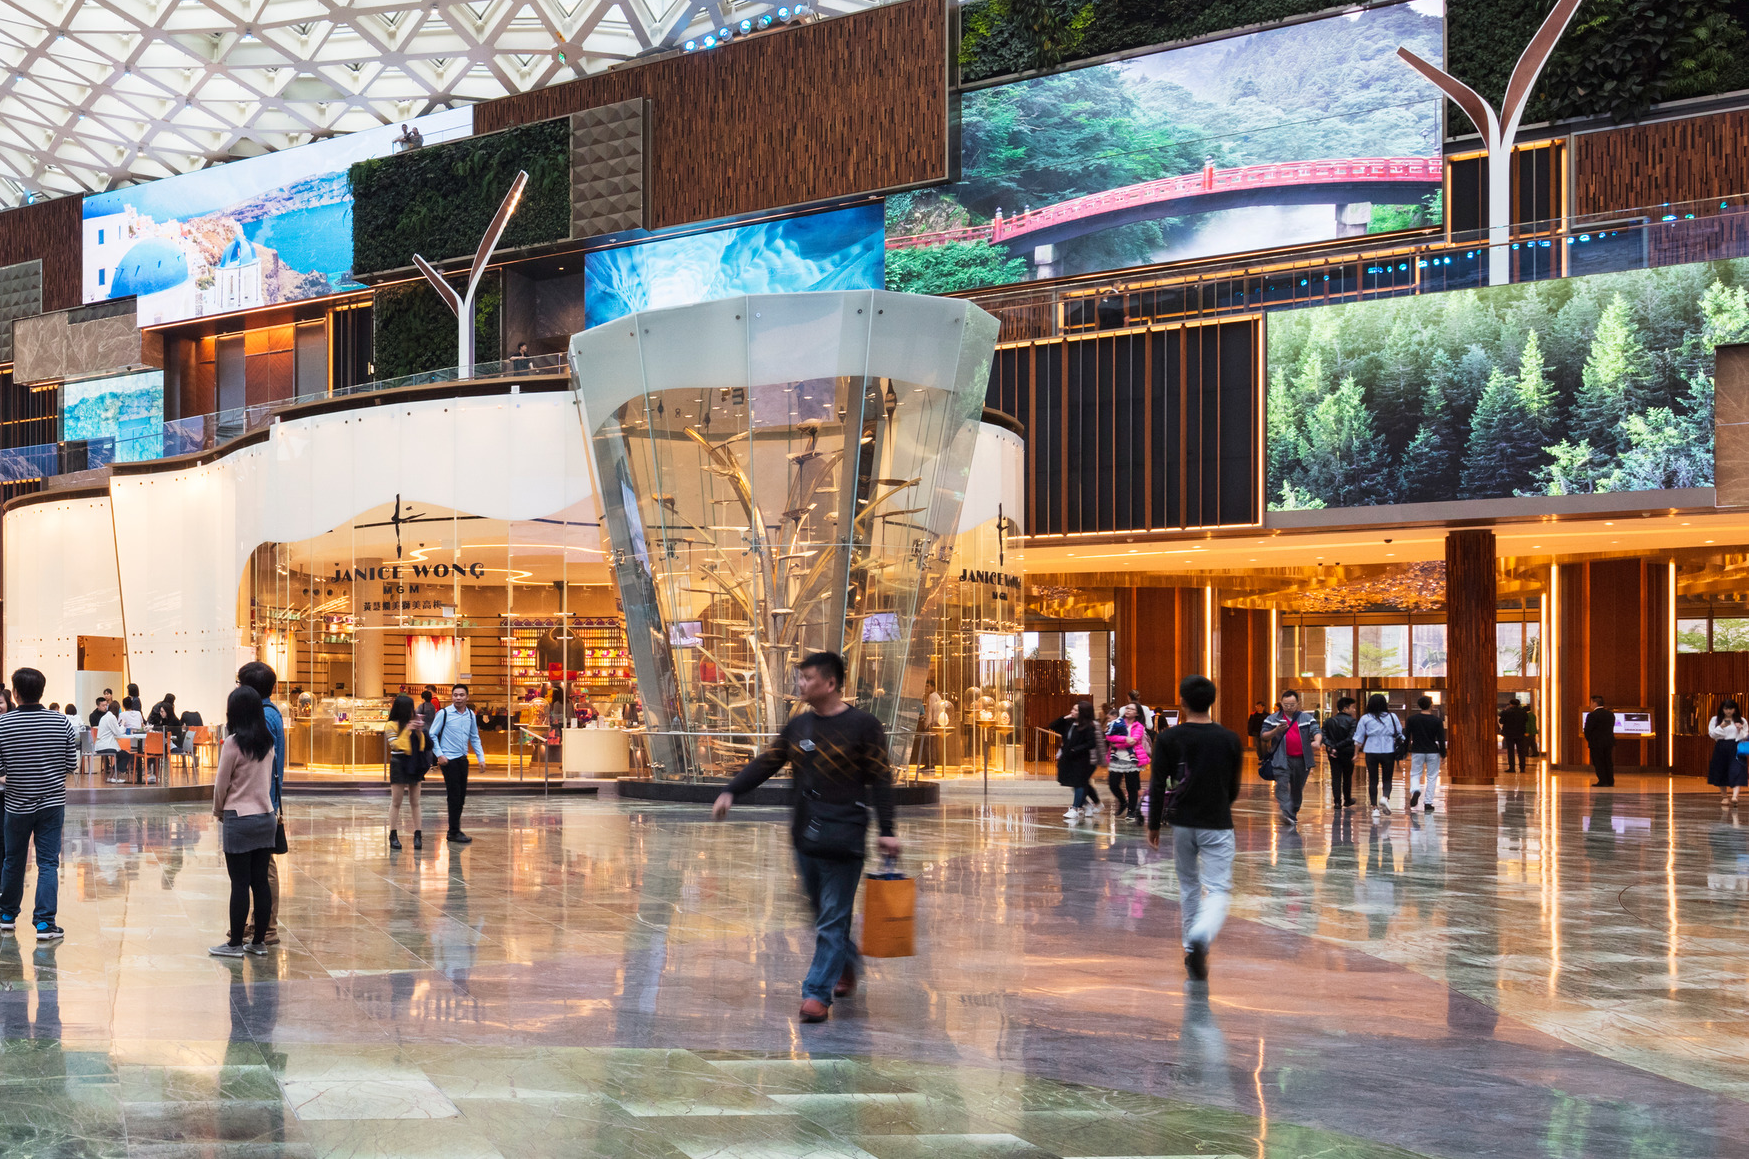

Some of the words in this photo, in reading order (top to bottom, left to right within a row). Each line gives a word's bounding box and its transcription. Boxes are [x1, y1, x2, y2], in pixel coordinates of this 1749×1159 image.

[331, 563, 404, 583] JANICE
[412, 562, 485, 579] WONG
[959, 569, 1004, 585] JANICE
[383, 585, 420, 595] MGM
